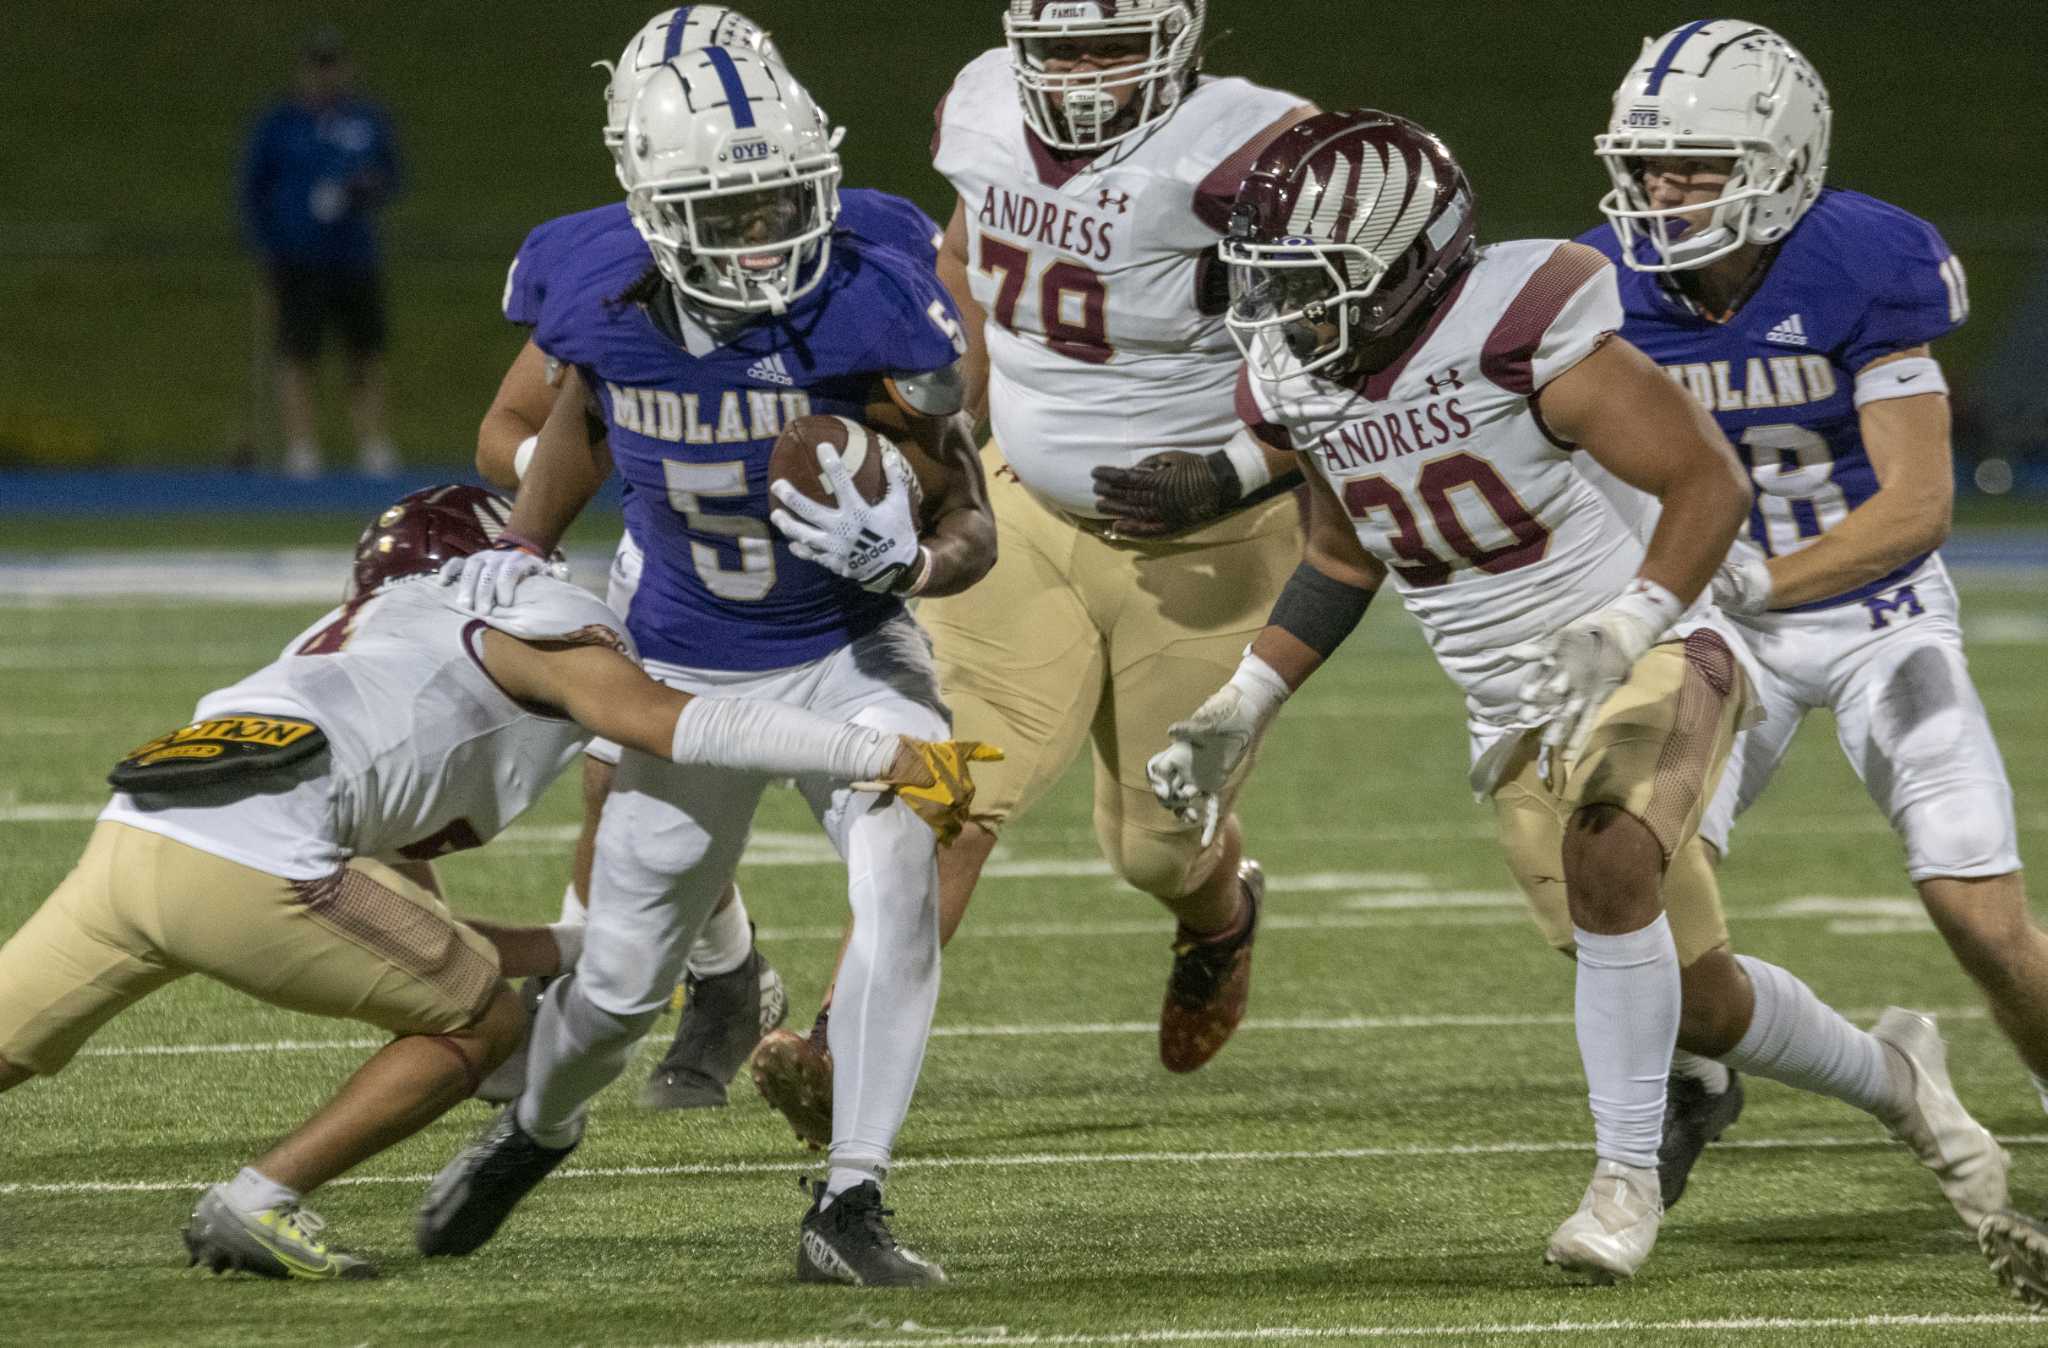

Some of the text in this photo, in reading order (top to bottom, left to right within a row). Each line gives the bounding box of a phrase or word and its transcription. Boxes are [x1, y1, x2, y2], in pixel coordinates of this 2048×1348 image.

[732, 142, 768, 160] OYB
[979, 186, 1113, 262] ANDRESS
[606, 381, 812, 444] MIDLAND
[1660, 354, 1836, 412] DLAND
[1320, 398, 1472, 472] ANDRESS
[662, 457, 778, 600] 5
[1341, 449, 1553, 589] 30
[848, 538, 896, 570] adidas
[1862, 585, 1926, 630] M
